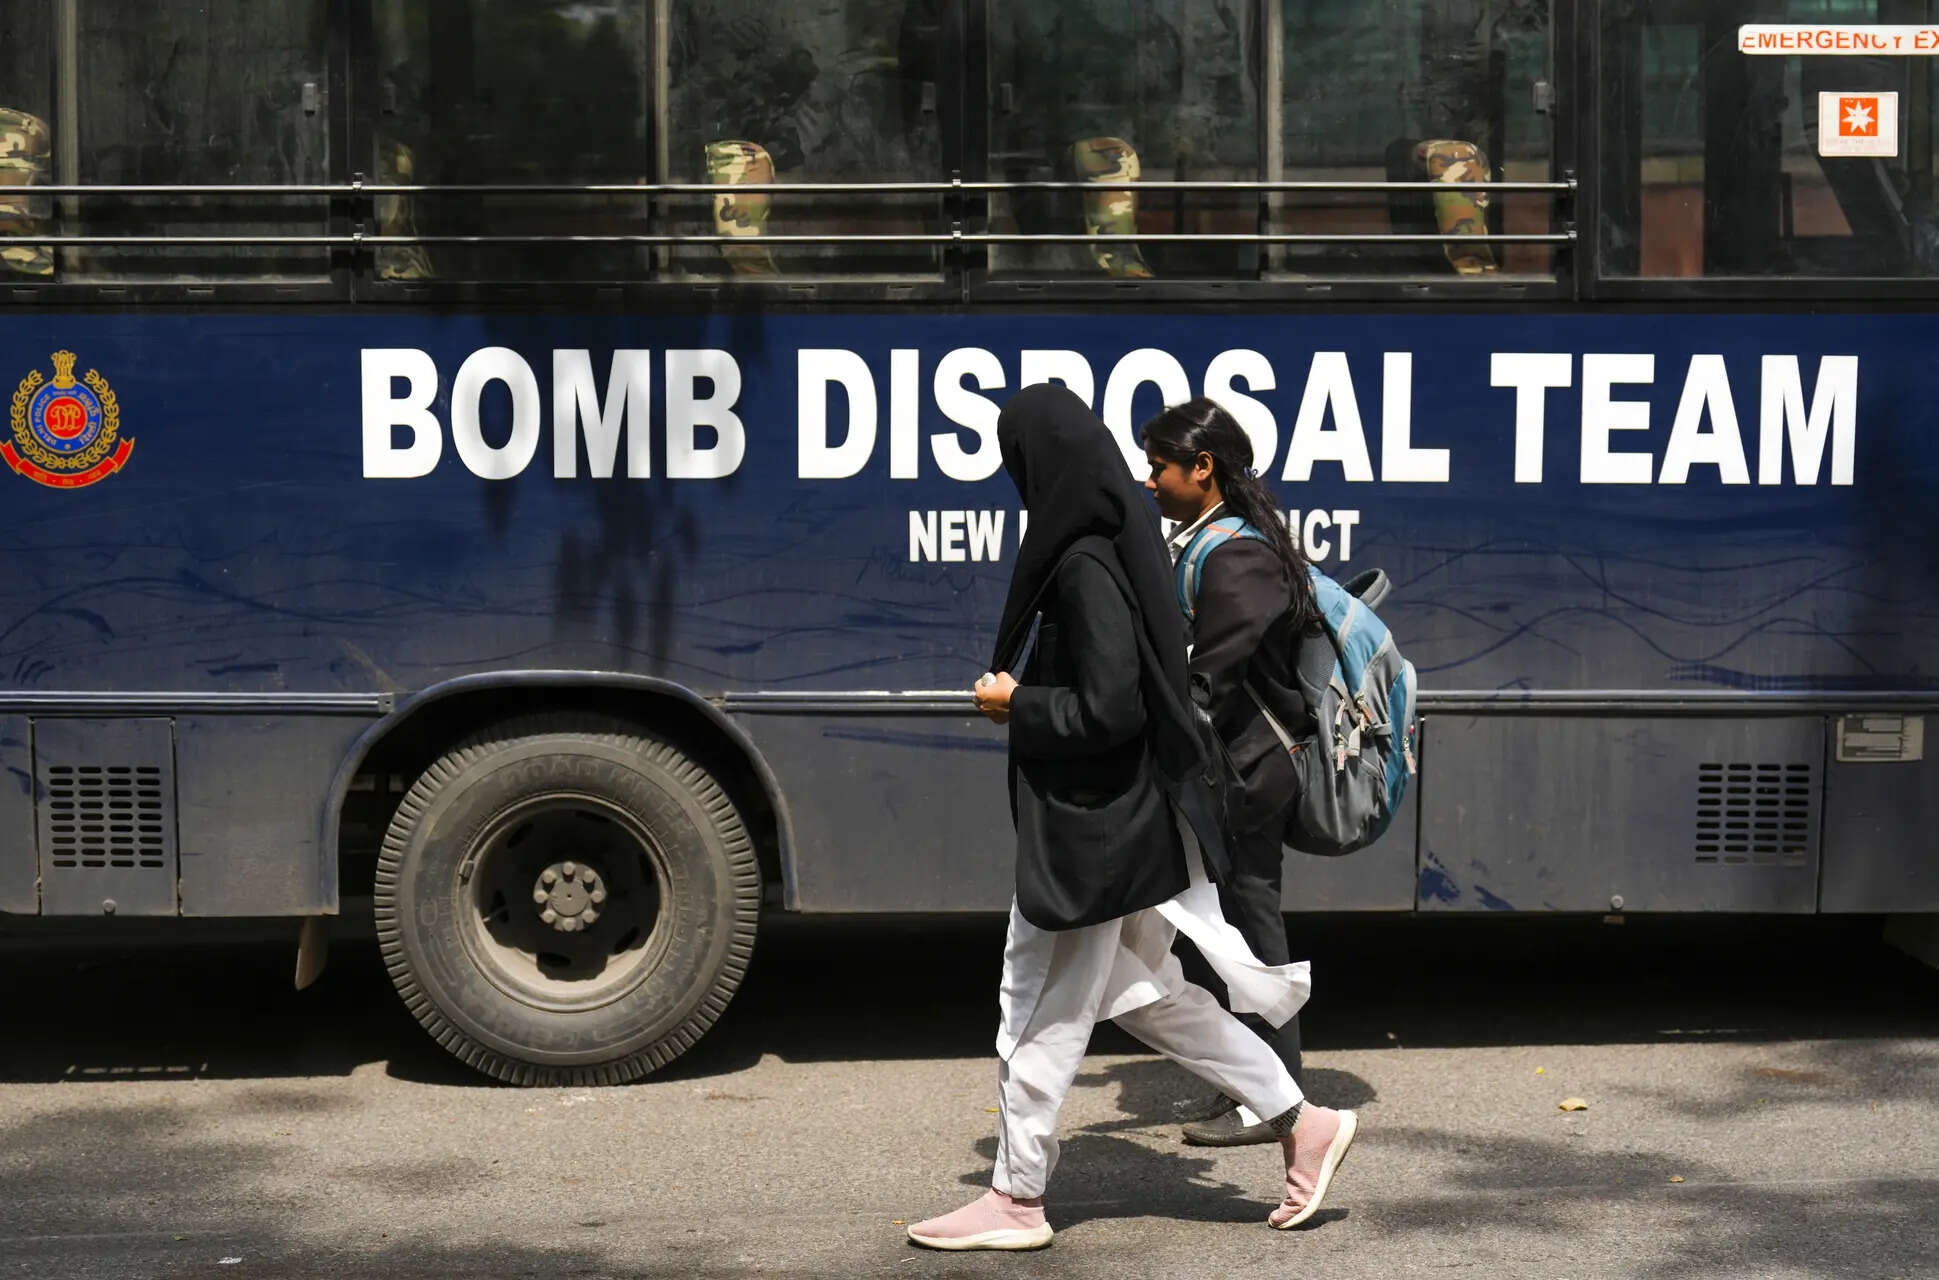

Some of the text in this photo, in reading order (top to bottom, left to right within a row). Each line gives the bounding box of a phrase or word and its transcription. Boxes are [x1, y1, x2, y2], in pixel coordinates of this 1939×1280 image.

[361, 346, 746, 480] BOMB
[1490, 352, 1859, 485] TEAM
[909, 510, 1006, 562] NEW
